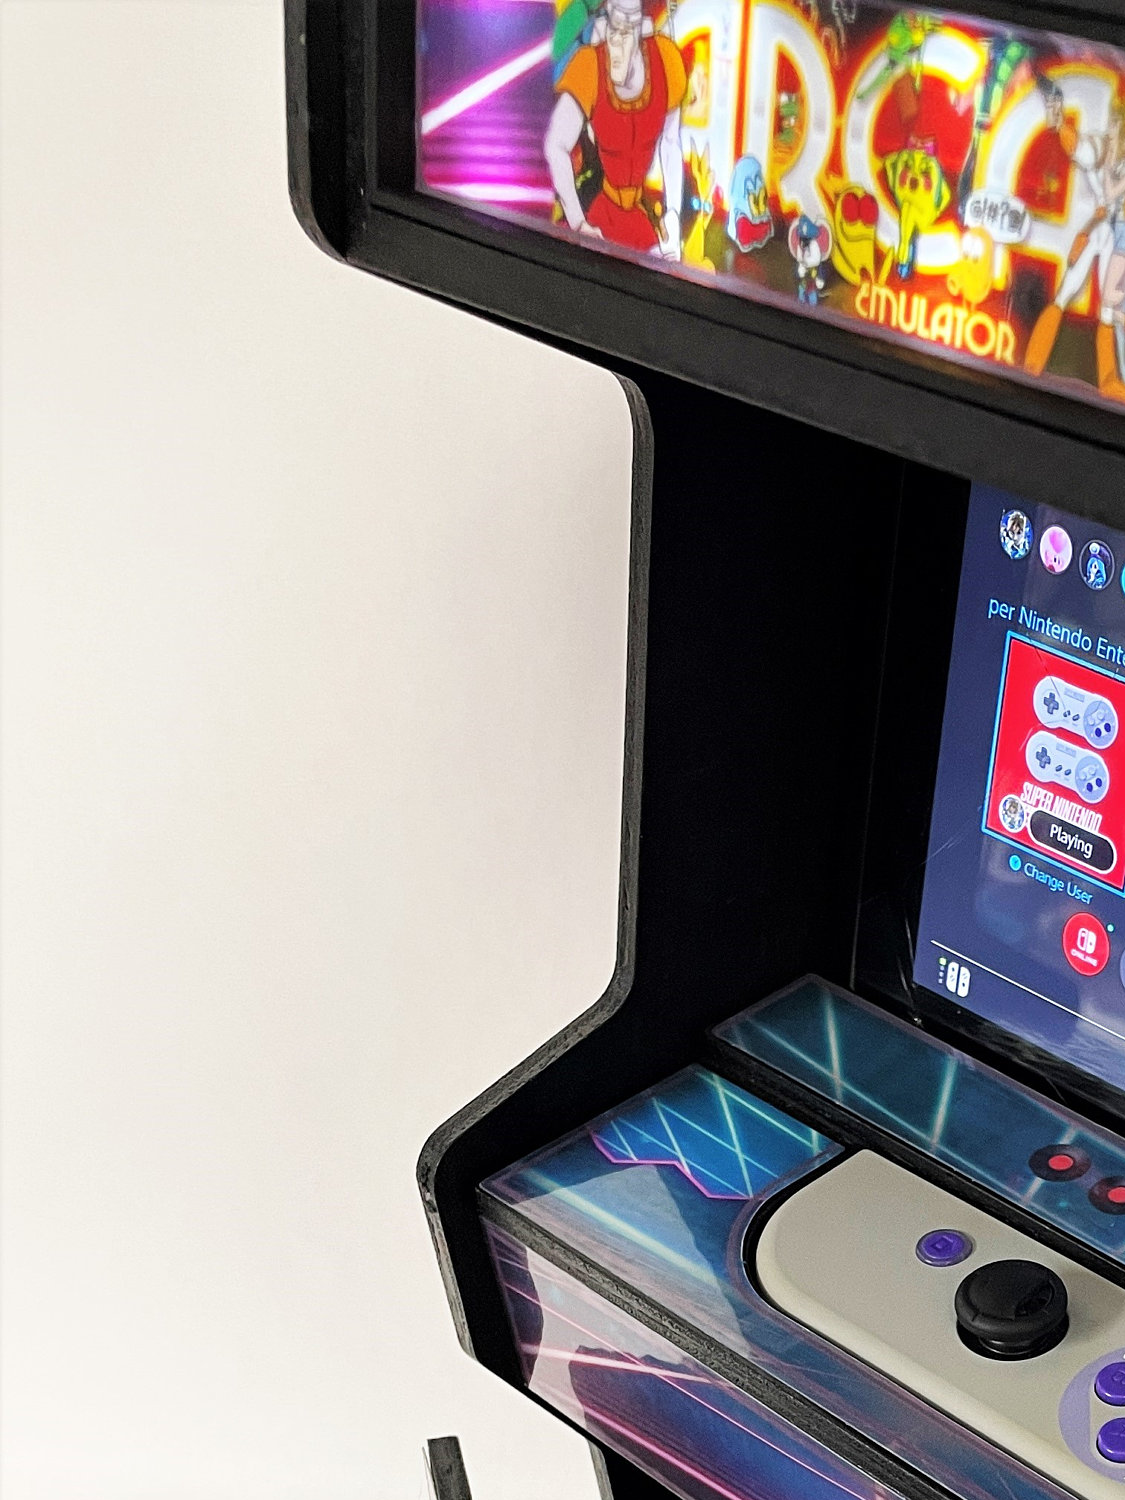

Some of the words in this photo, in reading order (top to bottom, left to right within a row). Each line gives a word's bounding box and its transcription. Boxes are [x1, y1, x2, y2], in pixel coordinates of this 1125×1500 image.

[855, 281, 1016, 366] EMULATOR
[988, 597, 1020, 620] per
[1018, 606, 1092, 651] Nintendo
[1020, 781, 1054, 812] SUPER
[1051, 796, 1103, 833] NINTENDO
[1049, 824, 1093, 859] Playing
[1024, 862, 1065, 892] Change
[1066, 881, 1093, 905] User
